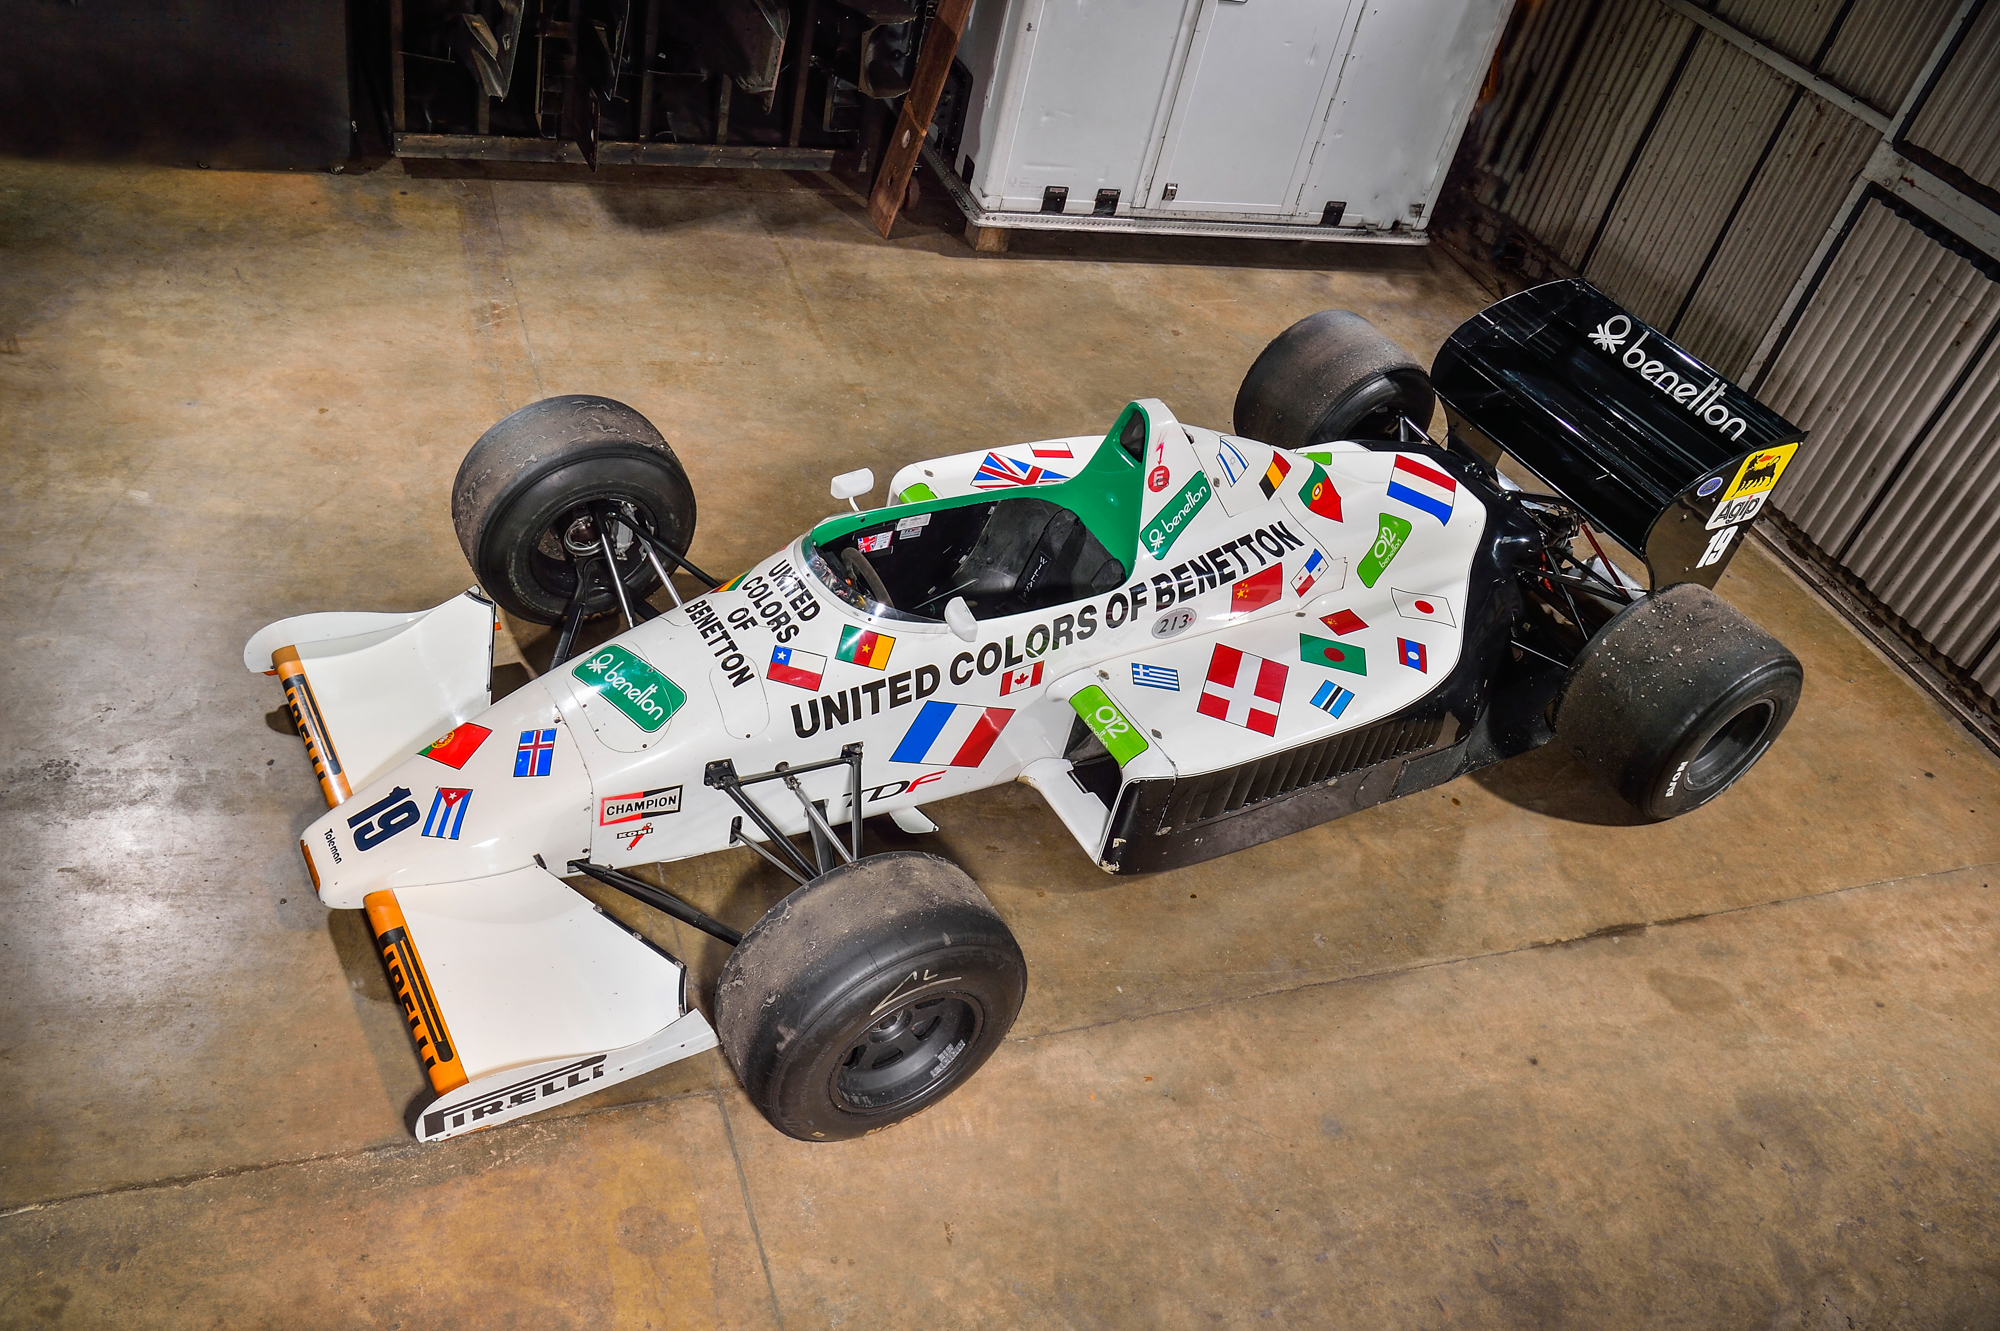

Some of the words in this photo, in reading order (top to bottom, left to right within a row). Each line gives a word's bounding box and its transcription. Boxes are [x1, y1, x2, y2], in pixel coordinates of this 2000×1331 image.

[1623, 331, 1747, 441] benetton
[1153, 470, 1165, 486] E
[1161, 486, 1207, 533] benetton
[1712, 495, 1760, 524] Agip
[1696, 525, 1739, 568] 19
[742, 576, 799, 643] COLORS
[768, 559, 821, 621] UNITED
[727, 607, 758, 630] OF
[791, 664, 941, 738] UNITED
[949, 605, 1097, 685] COLORS
[1106, 582, 1148, 629] OF
[1151, 521, 1305, 612] BENETTON
[1158, 614, 1189, 634] 213
[684, 600, 755, 688] BENETTON
[604, 661, 664, 720] benetton
[347, 786, 421, 851] 19
[607, 795, 677, 816] CHAMPION
[324, 828, 342, 864] Toleman
[617, 828, 653, 839] KONI
[424, 1054, 607, 1137] PIRELLI
